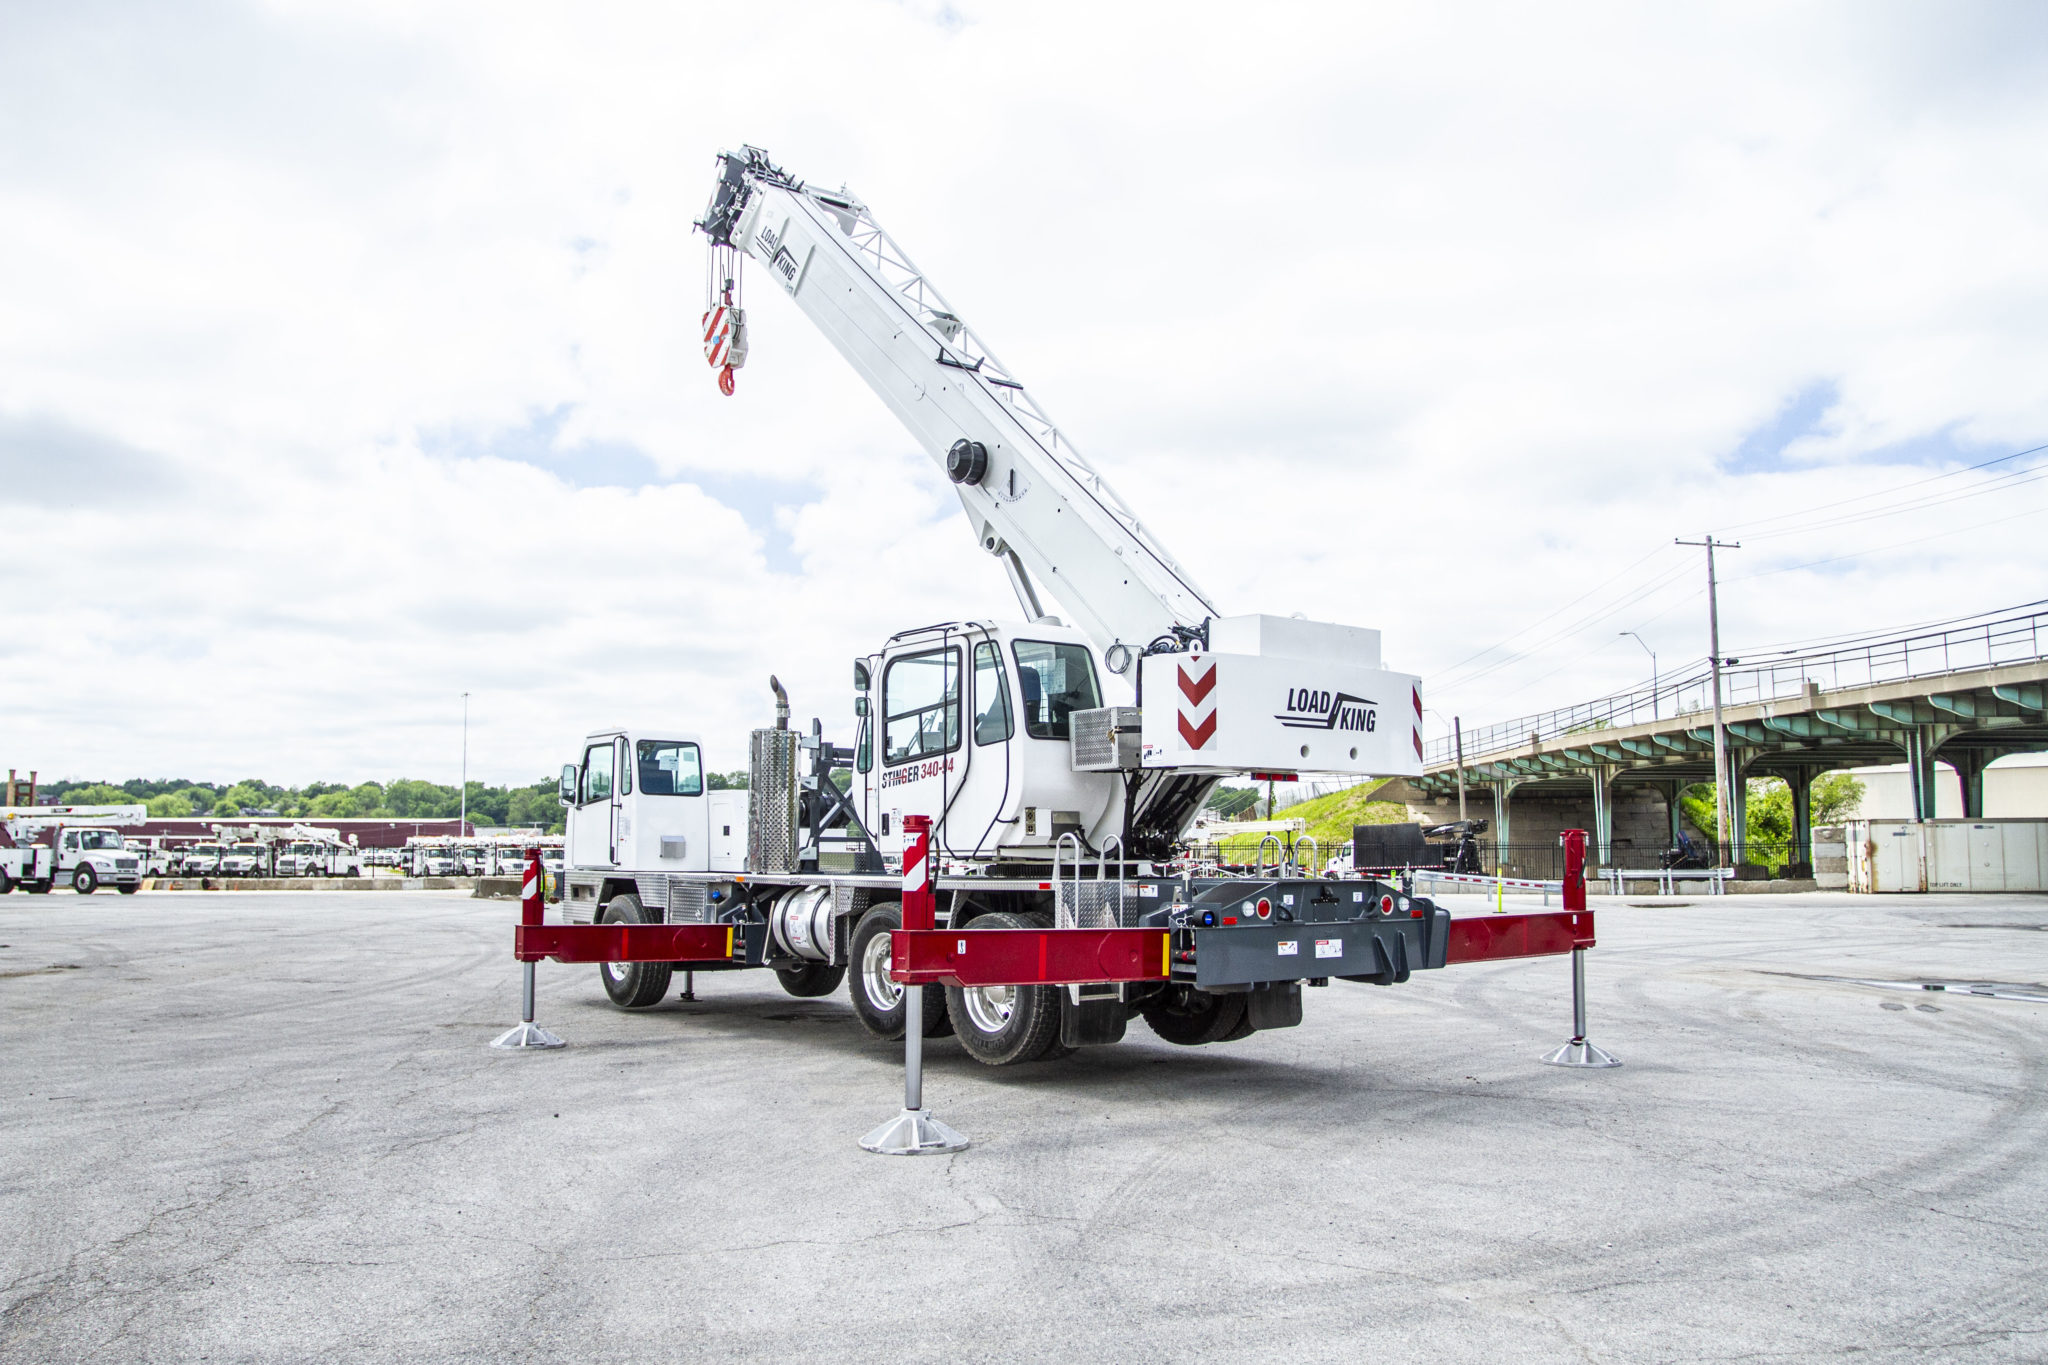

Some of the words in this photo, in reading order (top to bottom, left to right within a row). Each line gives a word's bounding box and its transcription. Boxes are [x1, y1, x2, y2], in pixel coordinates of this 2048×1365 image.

[776, 255, 796, 281] KING
[1287, 688, 1331, 714] LOAD
[1339, 707, 1376, 732] KING
[882, 765, 919, 789] STINGER
[921, 757, 954, 780] 340-94
